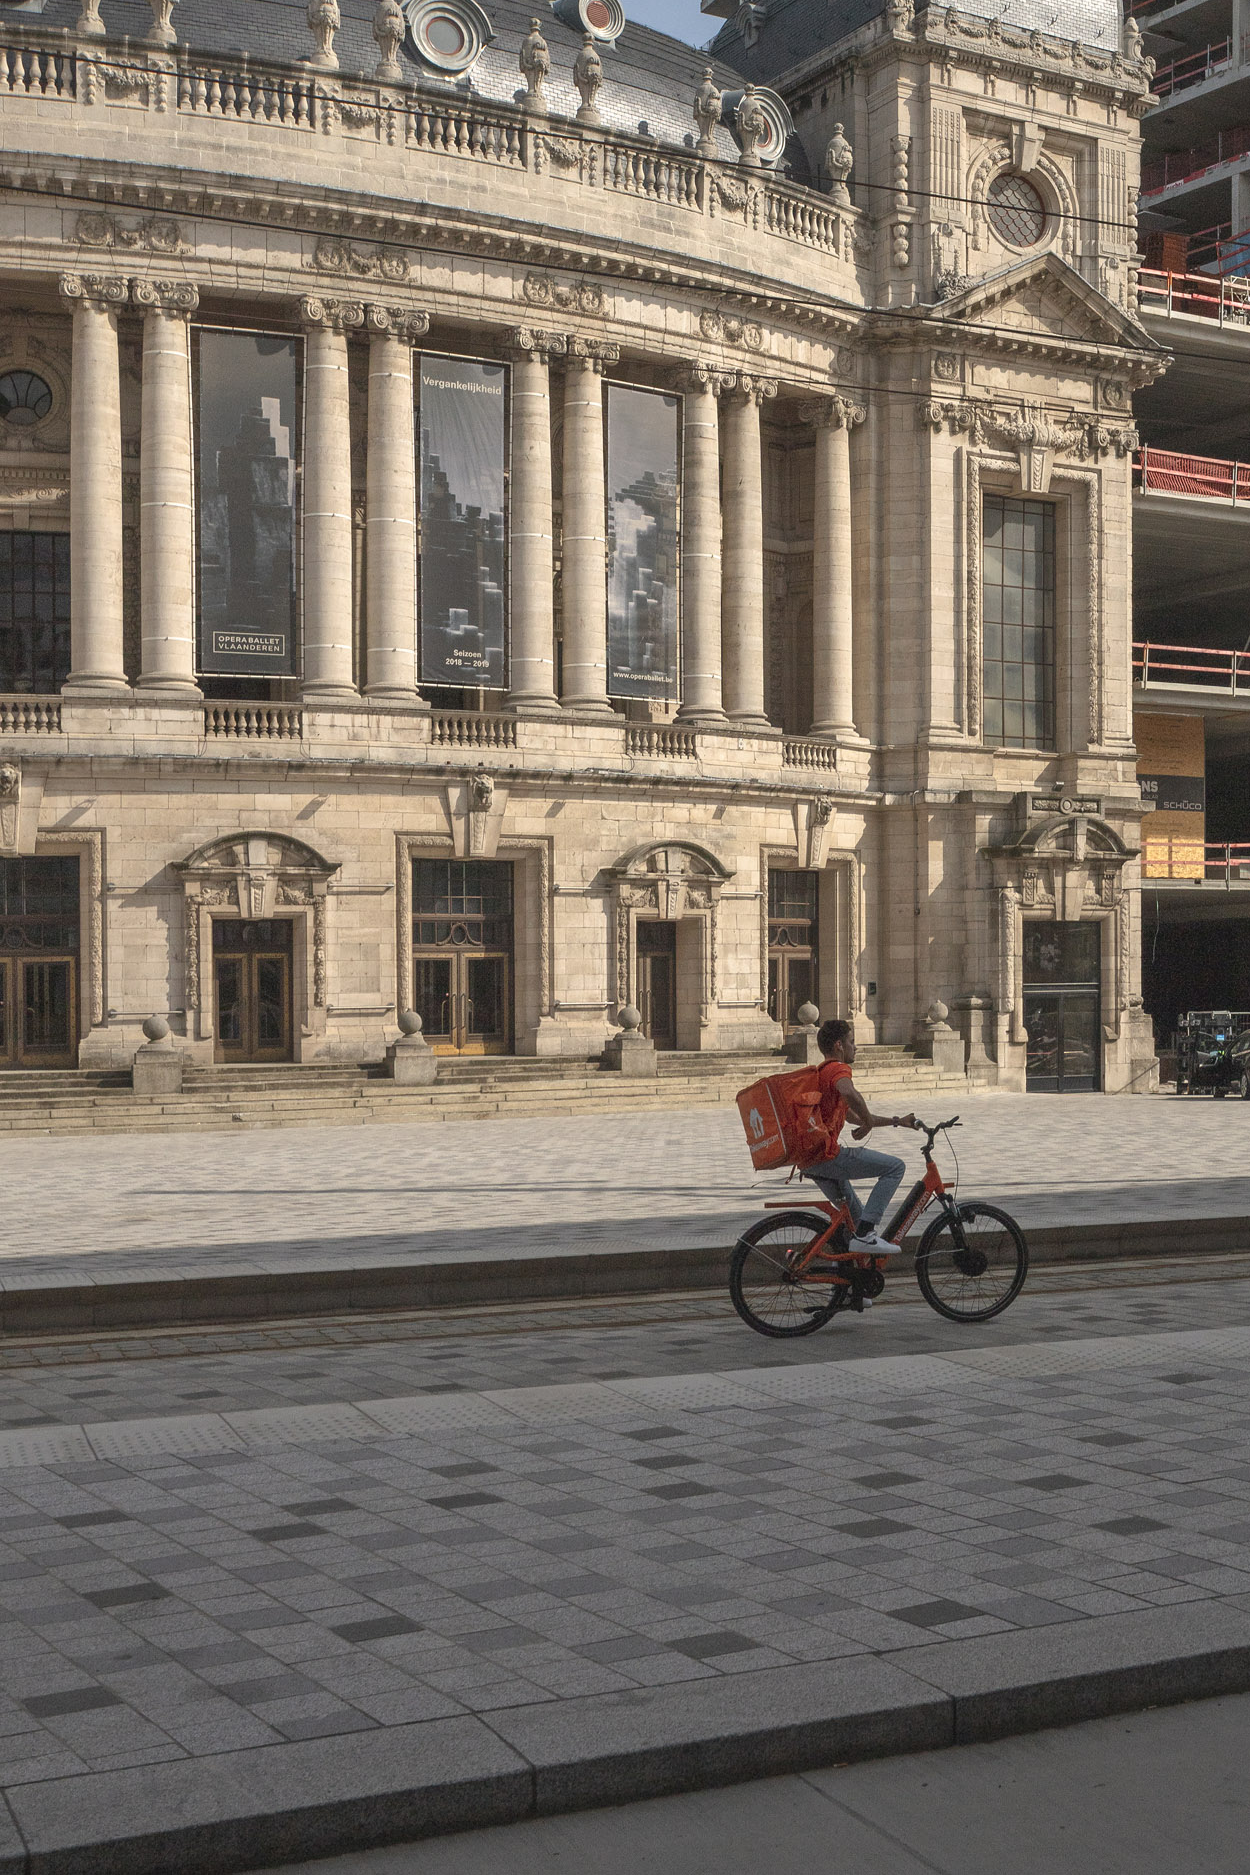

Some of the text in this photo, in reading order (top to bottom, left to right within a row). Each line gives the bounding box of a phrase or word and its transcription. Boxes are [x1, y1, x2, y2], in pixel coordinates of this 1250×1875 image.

[422, 375, 502, 395] Vergankelijkheid
[218, 635, 280, 644] OPERA BALLET
[218, 643, 280, 652] VLAANDEREN
[453, 649, 482, 658] Seizoen
[445, 658, 463, 666] 2018
[473, 659, 490, 668] 2019
[613, 671, 673, 683] www.operaballet.be
[1163, 800, 1202, 810] SCHÜCO
[893, 1190, 930, 1242] Takeaway.com
